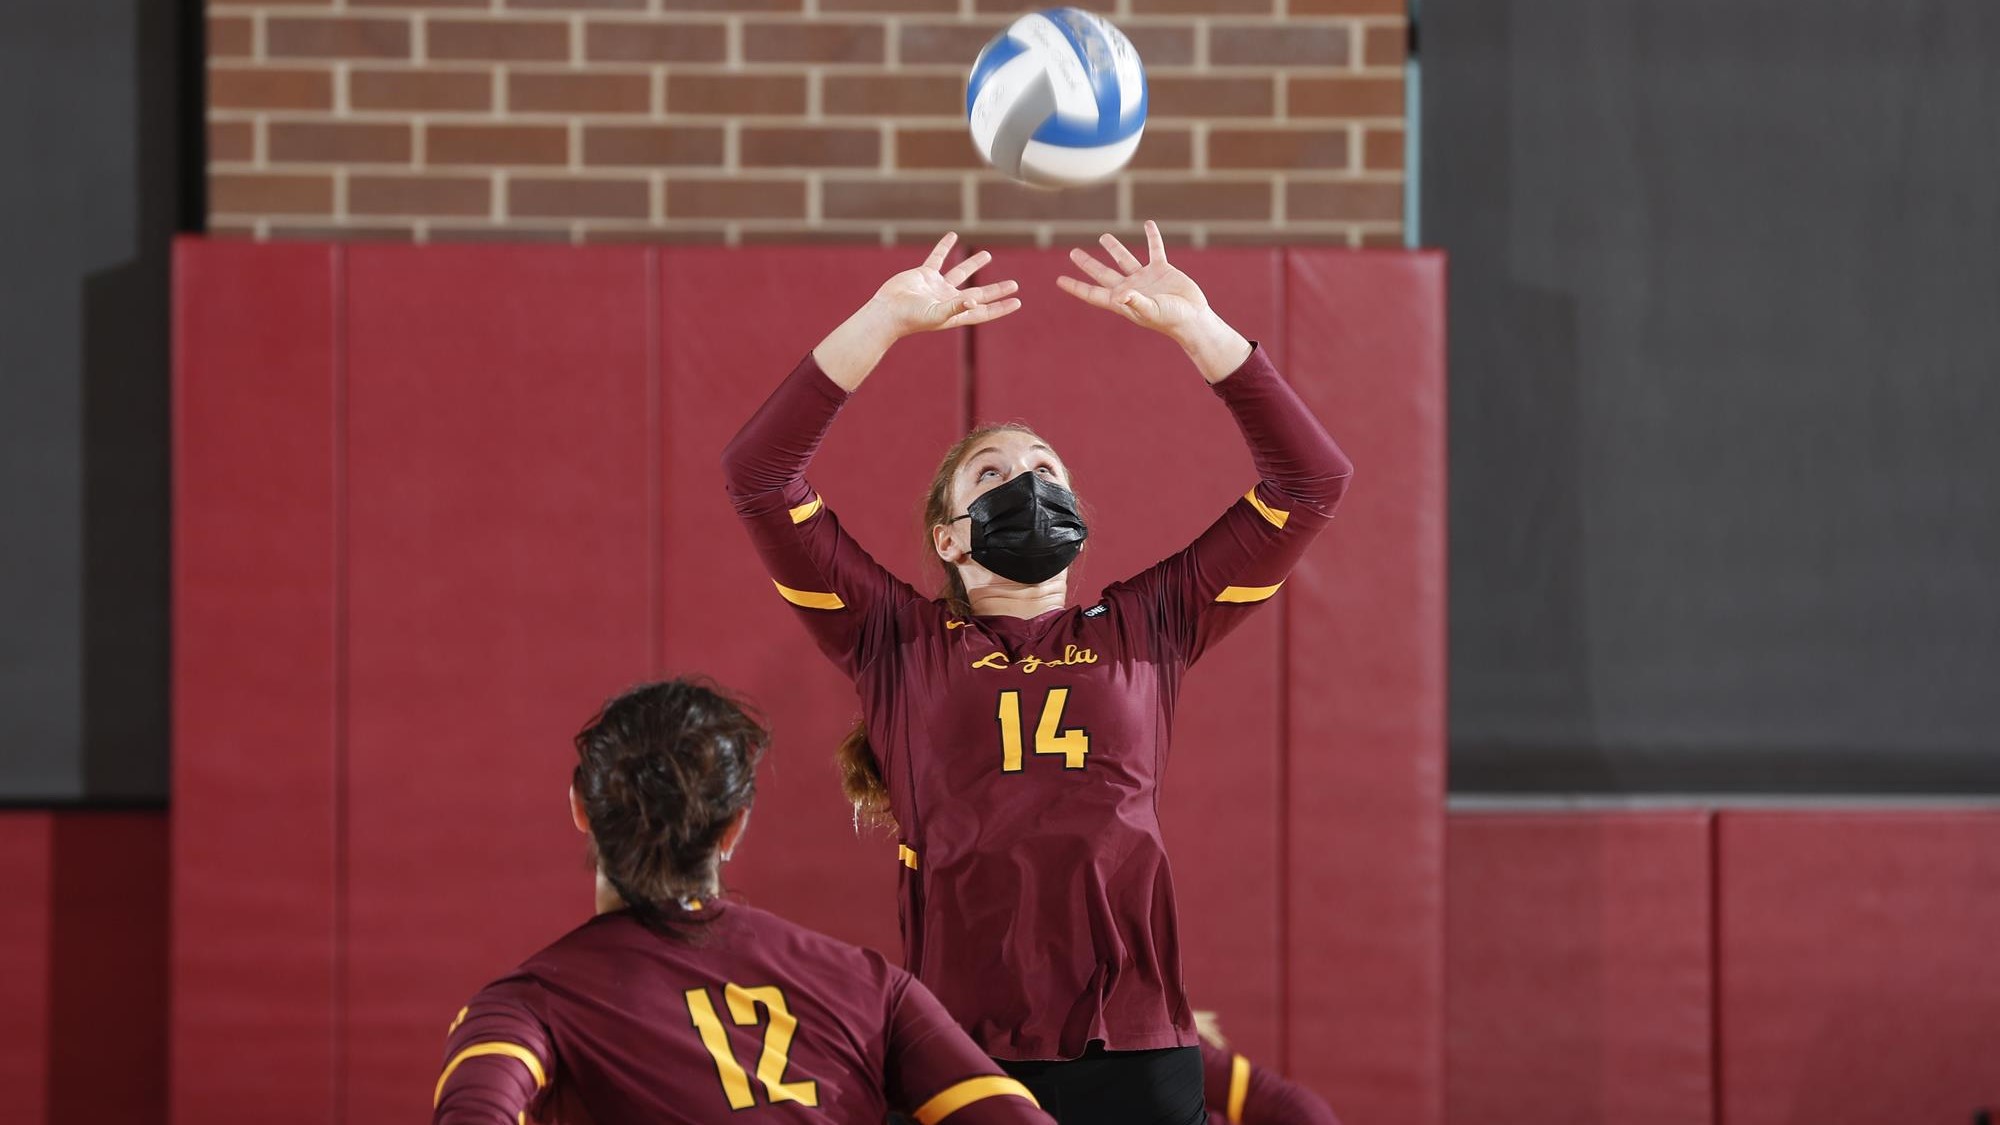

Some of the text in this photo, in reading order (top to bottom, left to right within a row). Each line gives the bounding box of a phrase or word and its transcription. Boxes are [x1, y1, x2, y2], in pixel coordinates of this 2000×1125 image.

[971, 644, 1098, 674] Lyola
[996, 687, 1090, 773] 14
[684, 981, 820, 1112] 12
